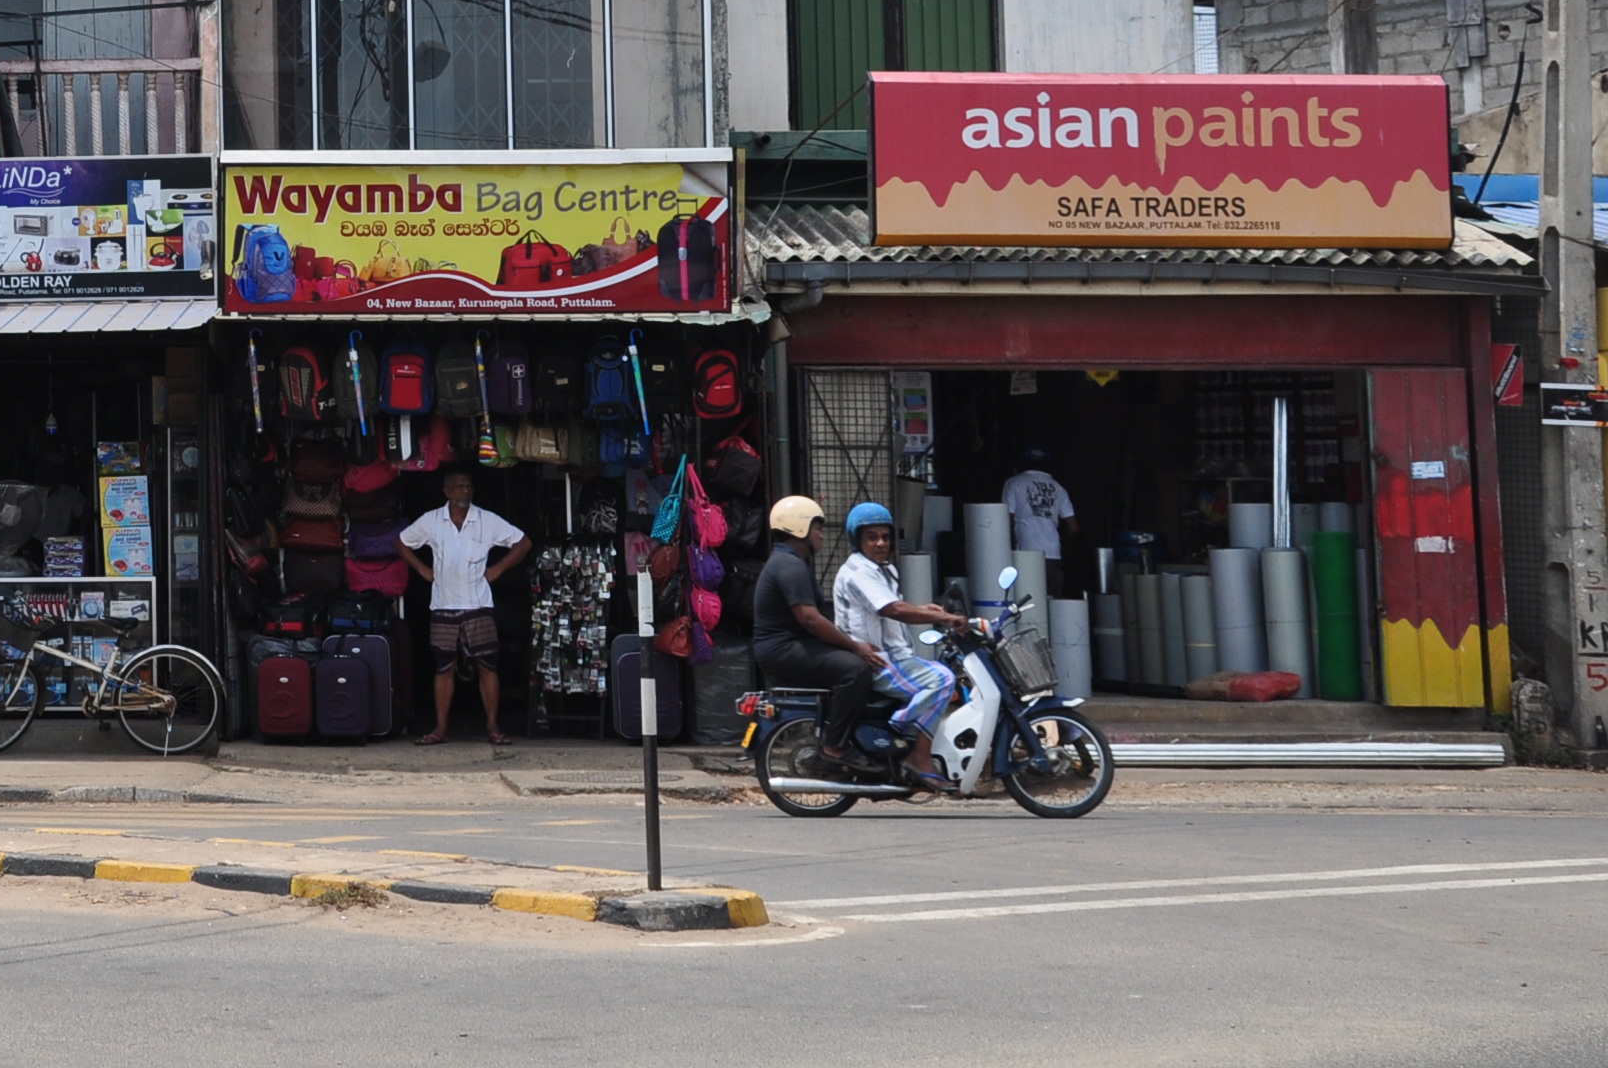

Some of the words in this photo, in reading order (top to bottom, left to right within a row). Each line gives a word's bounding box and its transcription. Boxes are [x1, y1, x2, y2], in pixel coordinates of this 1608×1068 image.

[961, 90, 1140, 150] asian
[1152, 90, 1362, 176] paints
[30, 198, 40, 206] My
[233, 172, 465, 224] Wayamba
[476, 181, 544, 221] Bag
[553, 179, 678, 213] Centre
[1057, 196, 1123, 218] SAFA
[1130, 196, 1246, 218] TRADERS
[340, 217, 388, 238] වයඹ
[1048, 221, 1063, 229] NO
[1066, 221, 1077, 229] 05
[1079, 221, 1101, 230] NEW
[44, 275, 72, 288] RAY
[106, 286, 117, 294] 071
[367, 298, 383, 309] 04,
[386, 298, 412, 309] New
[415, 298, 455, 309] Bazaar,
[458, 298, 524, 309] Kurunegala
[526, 298, 558, 309] Road,
[561, 297, 616, 308] Puttalam.
[1585, 663, 1608, 692] 5
